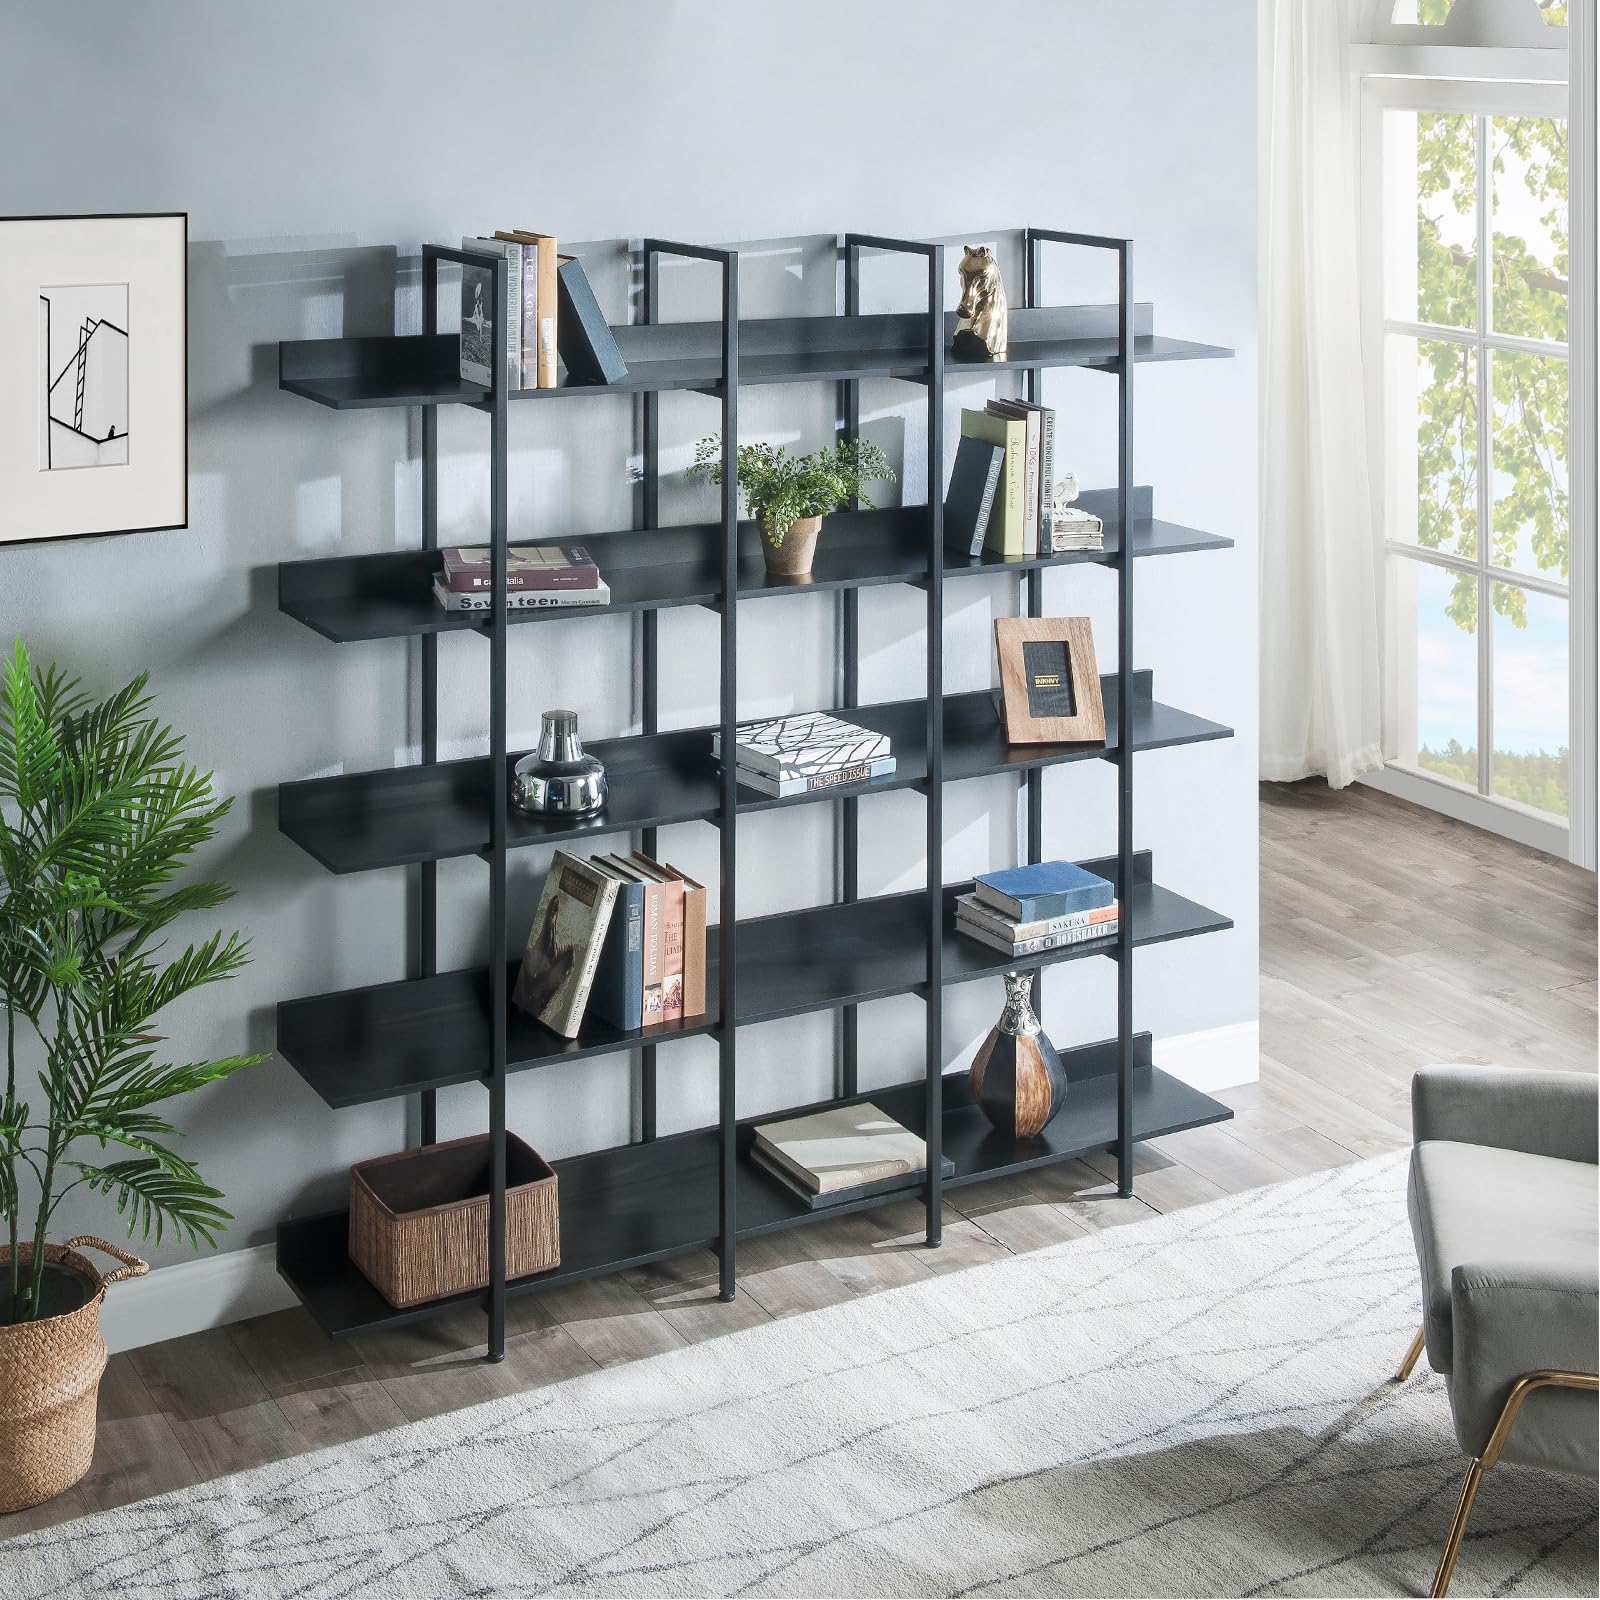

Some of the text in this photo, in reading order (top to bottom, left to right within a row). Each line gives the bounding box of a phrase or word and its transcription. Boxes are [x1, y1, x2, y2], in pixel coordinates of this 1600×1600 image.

[508, 249, 519, 273] CREATE
[508, 275, 519, 317] WONDERFUL
[526, 258, 534, 318] ICE AGE
[507, 319, 517, 353] HOMELIFE
[1009, 437, 1021, 477] Robinson
[1044, 416, 1054, 509] CREATE WONDERFUL HOMELIFE
[1026, 496, 1034, 521] Branding
[809, 766, 870, 788] THE SPEED ISSUE
[650, 894, 659, 977] ROMAN HOLIDAY
[1052, 916, 1085, 931] SAKURA
[1056, 924, 1109, 946] BONESHAKER
[664, 932, 678, 943] THE
[664, 944, 682, 957] ILIAD
